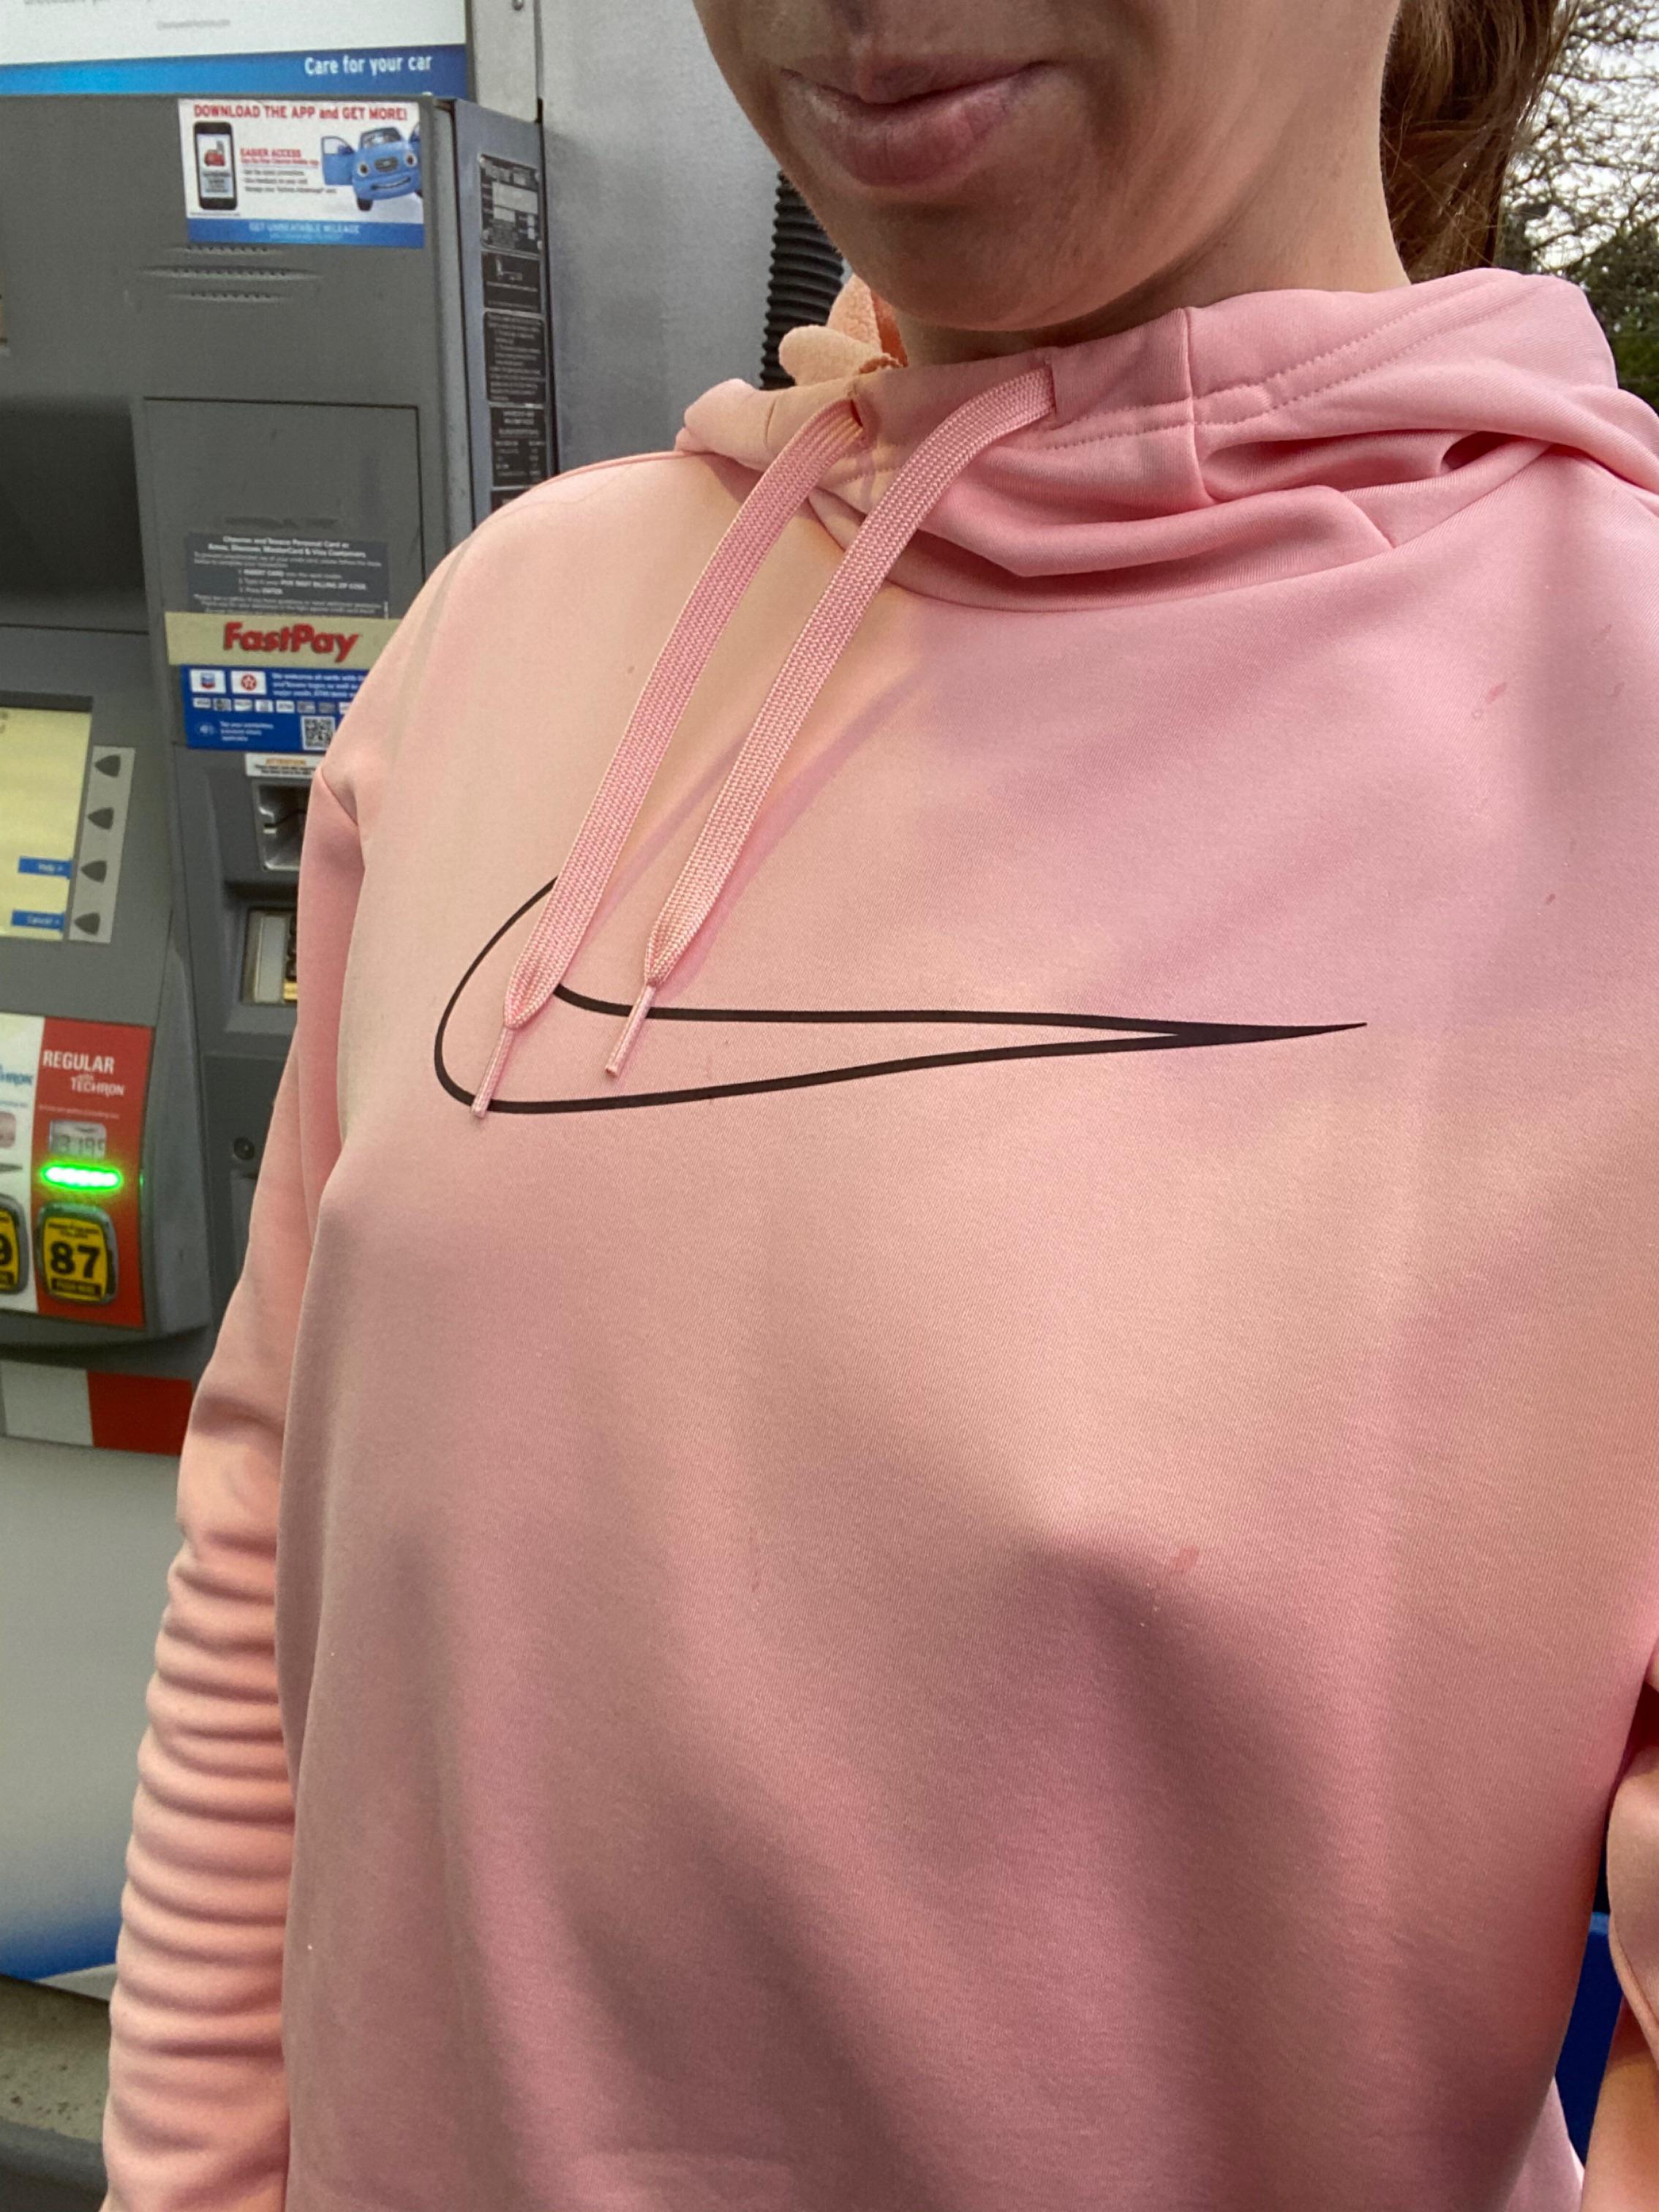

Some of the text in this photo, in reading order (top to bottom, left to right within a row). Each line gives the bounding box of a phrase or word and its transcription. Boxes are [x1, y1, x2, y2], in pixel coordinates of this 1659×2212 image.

[304, 54, 432, 76] Care for your car
[194, 104, 407, 121] DOWNLOAD THE APP and GET MORE!
[224, 622, 359, 663] FastPay
[42, 1049, 116, 1075] REGULAR
[71, 1075, 124, 1097] TECHRON
[50, 1240, 100, 1279] 87
